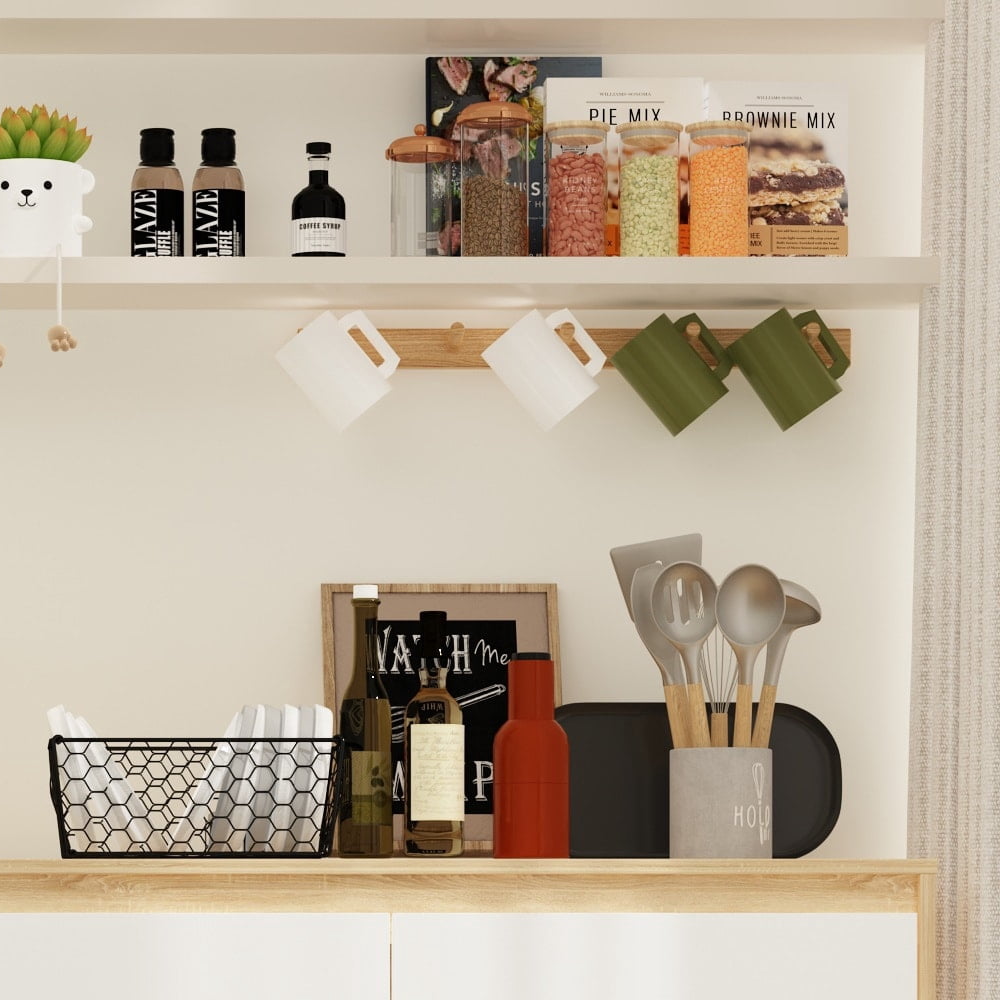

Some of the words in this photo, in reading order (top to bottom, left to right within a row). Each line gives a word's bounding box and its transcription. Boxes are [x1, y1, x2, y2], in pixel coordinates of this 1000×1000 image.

[589, 108, 618, 126] PIE
[629, 108, 661, 123] MIX
[722, 111, 798, 129] BROWNIE
[807, 112, 836, 129] MIX
[299, 222, 321, 230] COFFEE
[322, 222, 341, 230] SYRUP
[157, 230, 172, 257] UFFLE
[218, 230, 233, 257] UFFLE
